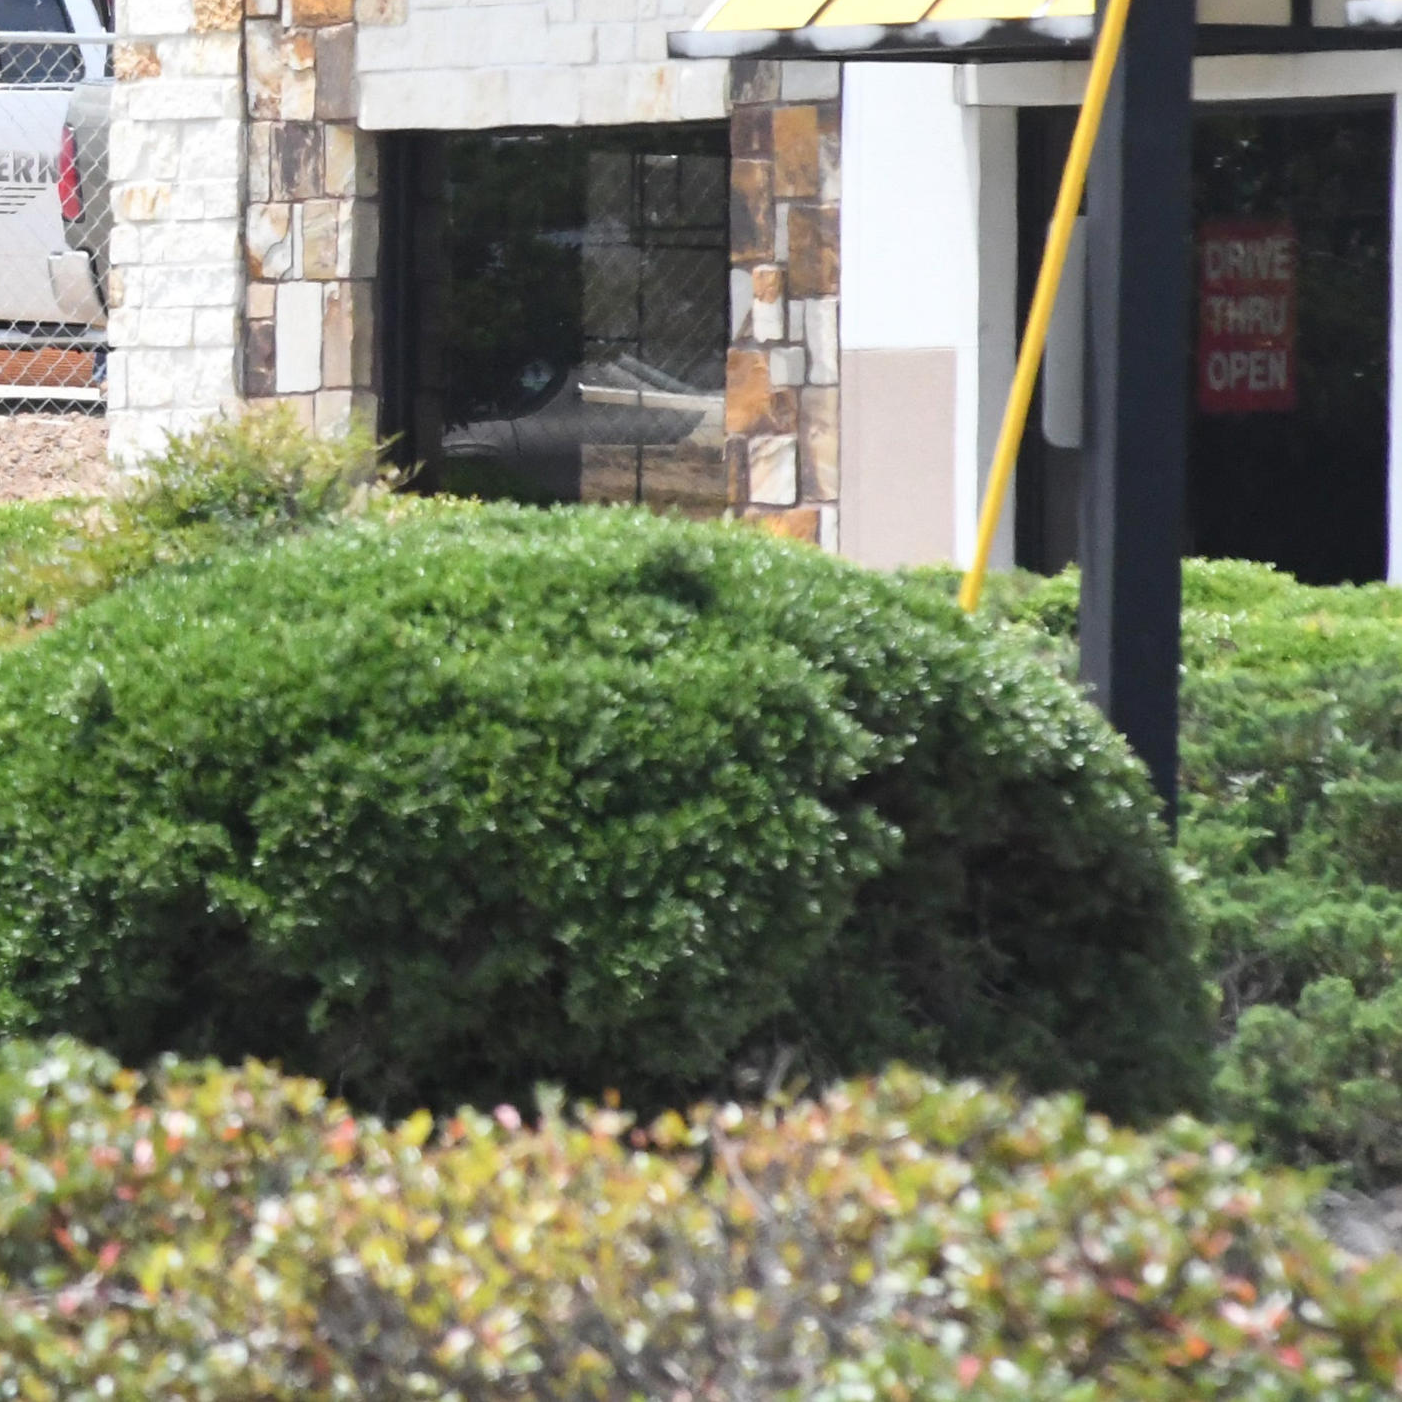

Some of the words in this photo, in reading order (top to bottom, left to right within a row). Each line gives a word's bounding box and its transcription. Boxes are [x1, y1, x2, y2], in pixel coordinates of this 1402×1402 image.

[1204, 239, 1292, 280] DRIVE
[1209, 295, 1288, 336] THRU
[1208, 351, 1288, 391] OPEN
